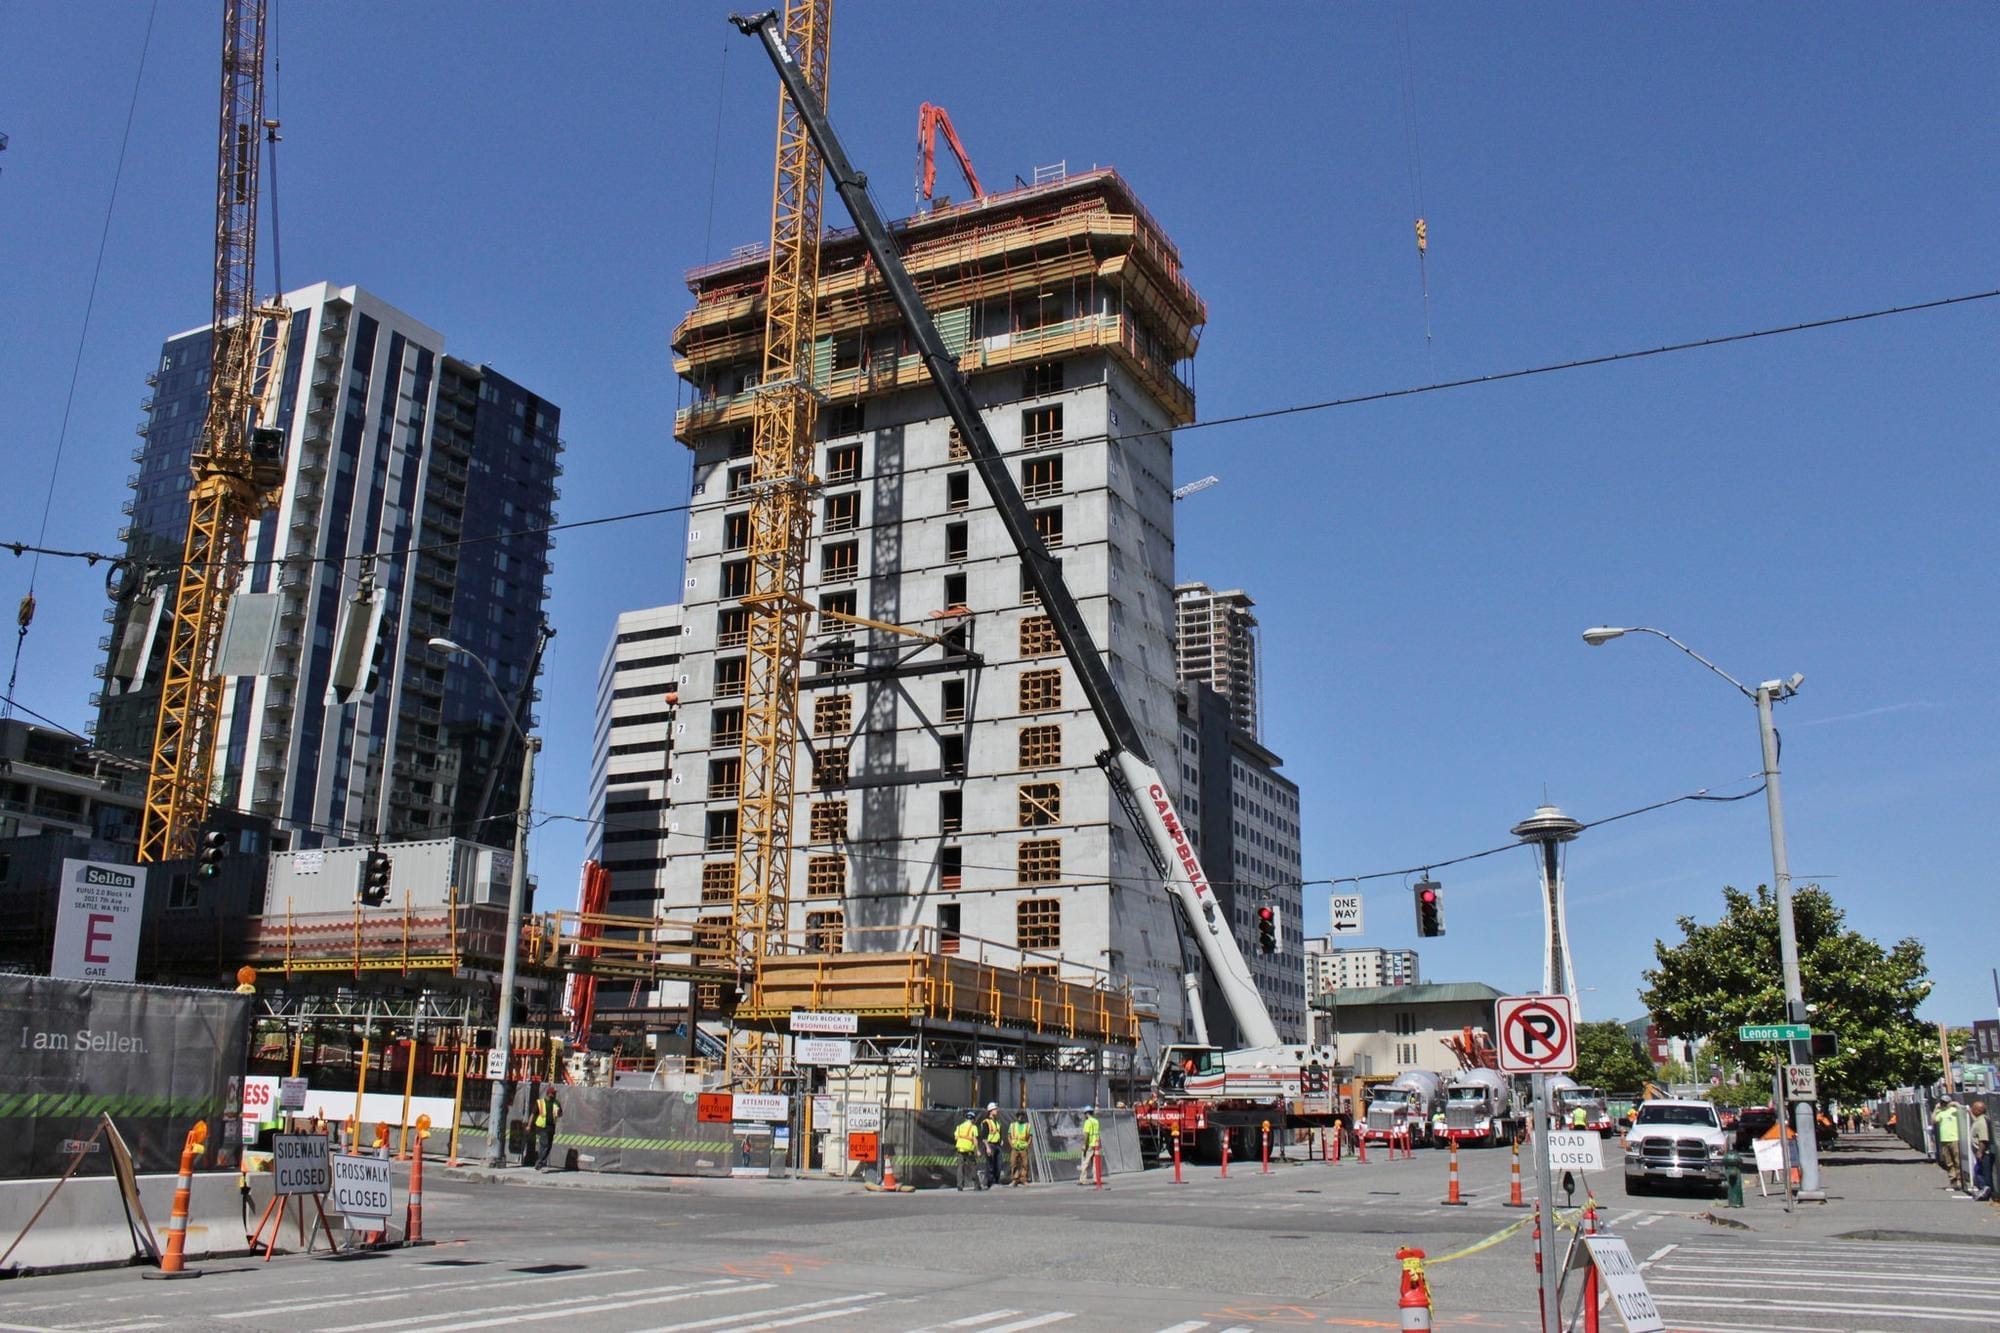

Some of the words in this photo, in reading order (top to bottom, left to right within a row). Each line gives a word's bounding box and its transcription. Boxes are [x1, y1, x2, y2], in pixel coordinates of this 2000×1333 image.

[693, 485, 703, 495] 12
[690, 531, 699, 540] 11
[685, 626, 690, 635] 9
[682, 676, 687, 684] 8
[678, 725, 684, 733] 7
[675, 774, 681, 783] 6
[1149, 784, 1208, 900] CAMPBELL
[87, 870, 132, 886] Sellen
[76, 887, 95, 895] RUFUS
[1334, 899, 1357, 908] ONE
[1334, 910, 1357, 918] WAY
[84, 913, 114, 963] E
[85, 967, 107, 976] GATE
[1742, 1028, 1778, 1039] Lenora
[1786, 1030, 1795, 1038] St
[20, 1026, 29, 1049] I
[33, 1032, 69, 1050] am
[74, 1030, 148, 1053] Sellen.
[1790, 1067, 1811, 1076] ONE
[1790, 1078, 1812, 1086] WAY
[742, 1098, 780, 1107] ATTENTION
[700, 1104, 729, 1113] DETOUR
[849, 1106, 879, 1115] SIDEWALK
[849, 1119, 878, 1127] CLOSED
[1549, 1136, 1585, 1146] ROAD
[278, 1142, 326, 1159] SIDEWALK
[850, 1144, 875, 1152] DETOUR
[1550, 1153, 1593, 1163] LOSED
[336, 1162, 388, 1183] CROSSWALK
[281, 1169, 325, 1186] CLOSED
[340, 1189, 387, 1208] CLOSED
[1617, 1292, 1656, 1321] CLOSED
